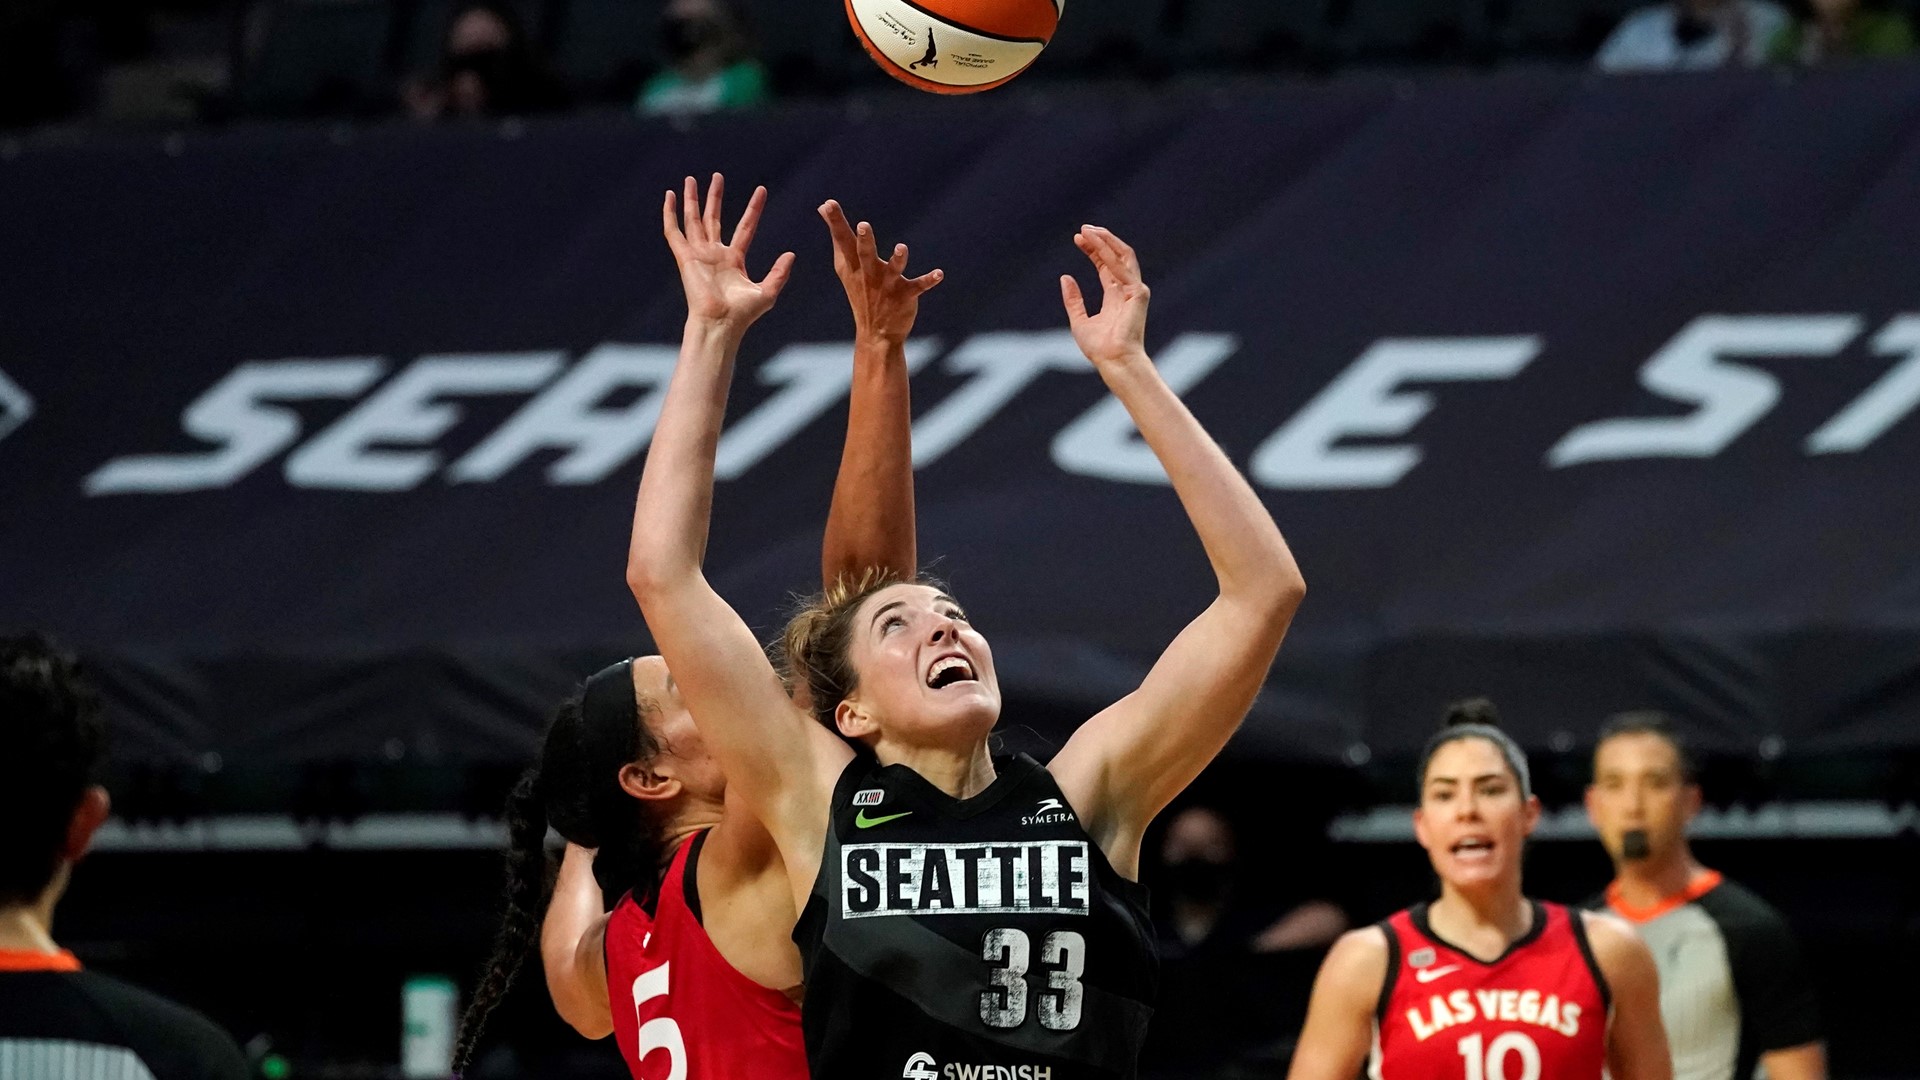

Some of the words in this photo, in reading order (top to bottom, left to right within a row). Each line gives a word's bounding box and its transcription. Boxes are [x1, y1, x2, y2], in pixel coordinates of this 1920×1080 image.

[953, 60, 988, 68] OFFICIAL
[1021, 813, 1075, 826] SYMETRA
[847, 848, 1084, 911] SEATTLE
[979, 928, 1086, 1031] 33
[632, 960, 688, 1080] 5
[1407, 989, 1477, 1042] LAS
[1478, 989, 1582, 1037] VEGAS
[943, 1062, 1052, 1080] SWEDISH
[1458, 1030, 1542, 1080] 10
